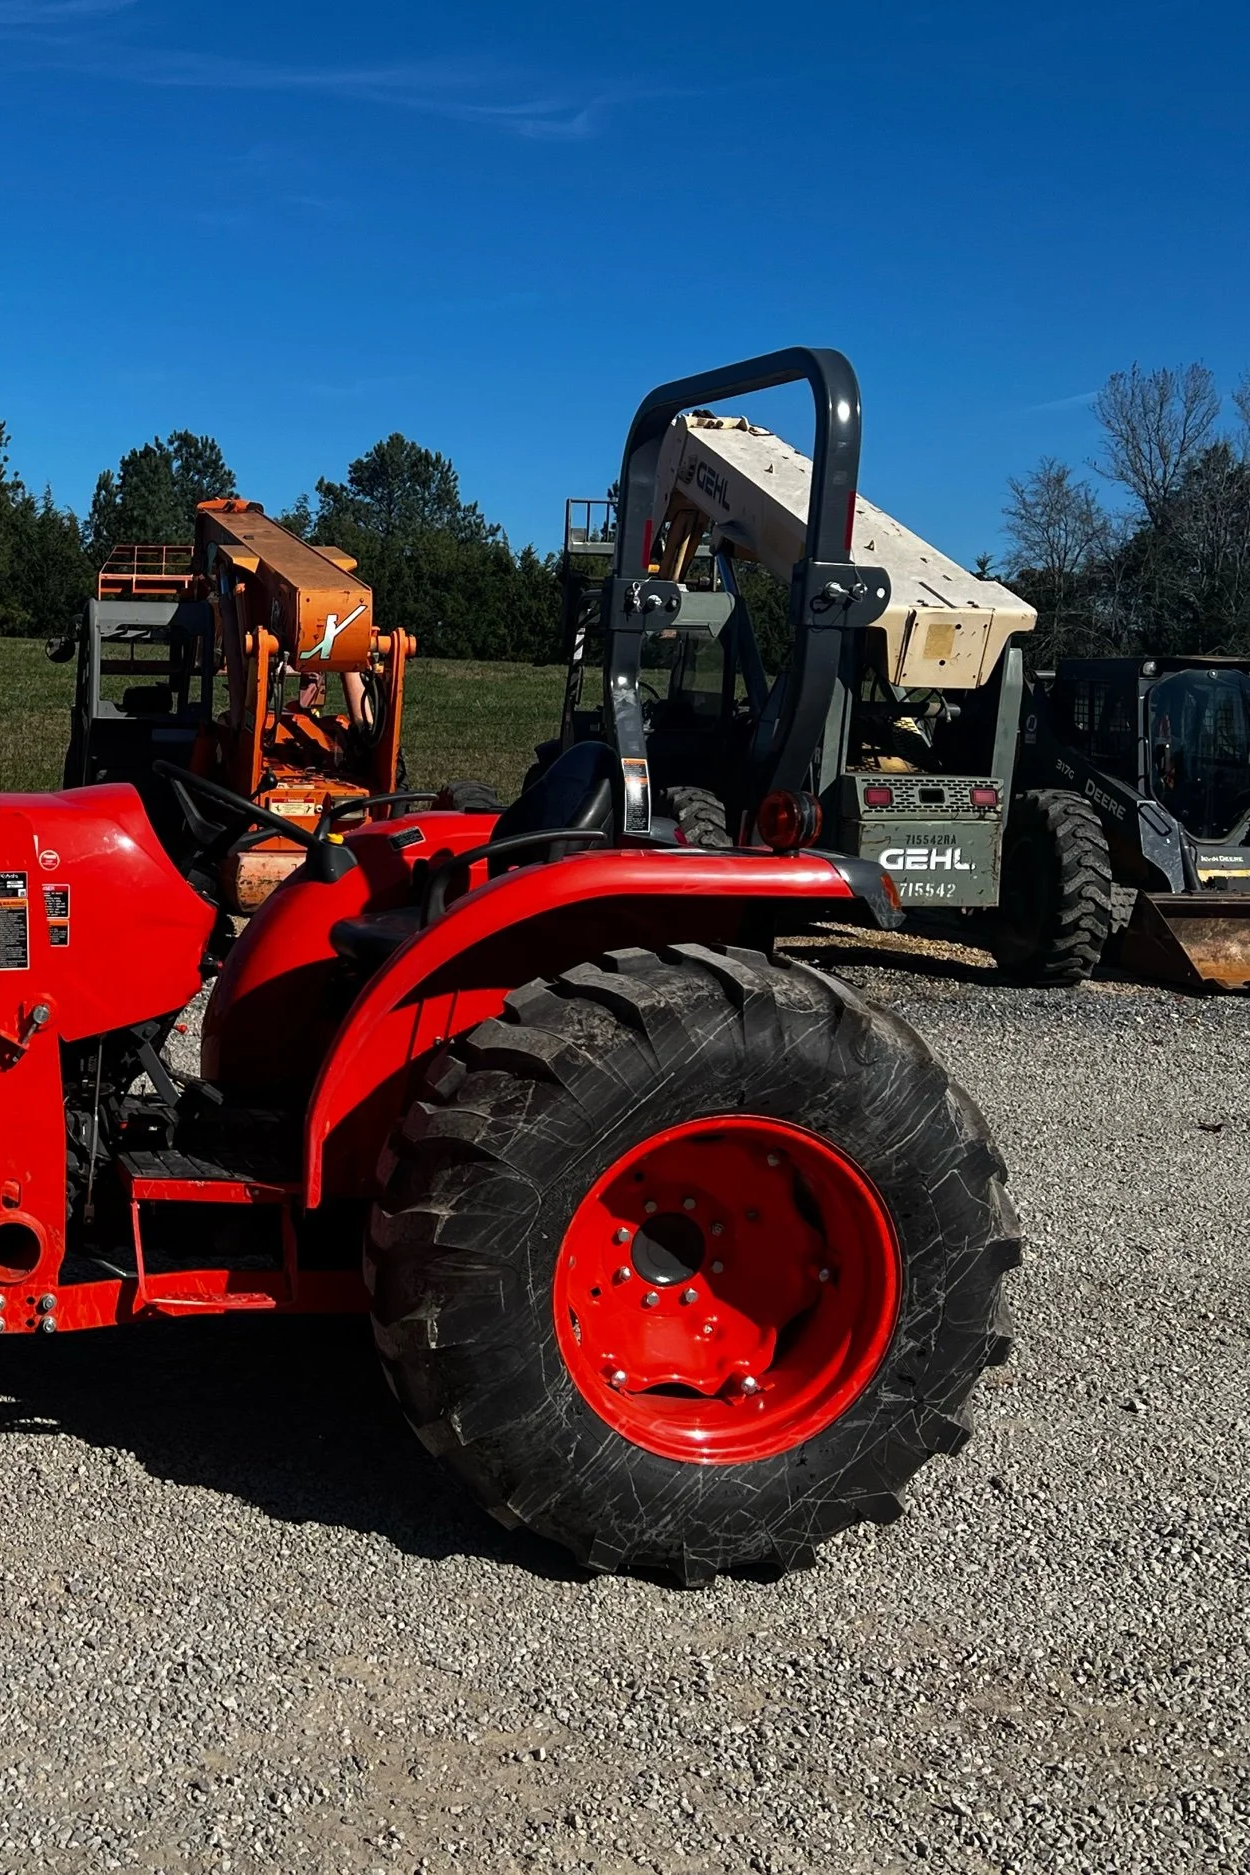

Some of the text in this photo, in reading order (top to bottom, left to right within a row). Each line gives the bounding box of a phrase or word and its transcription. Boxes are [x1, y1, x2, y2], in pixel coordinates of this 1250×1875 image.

[696, 461, 730, 512] GEHL
[1056, 759, 1075, 780] 317G
[1085, 779, 1126, 820] DEERE
[905, 834, 957, 845] 715542RA
[879, 847, 975, 870] GEHL
[899, 883, 956, 898] 715542
